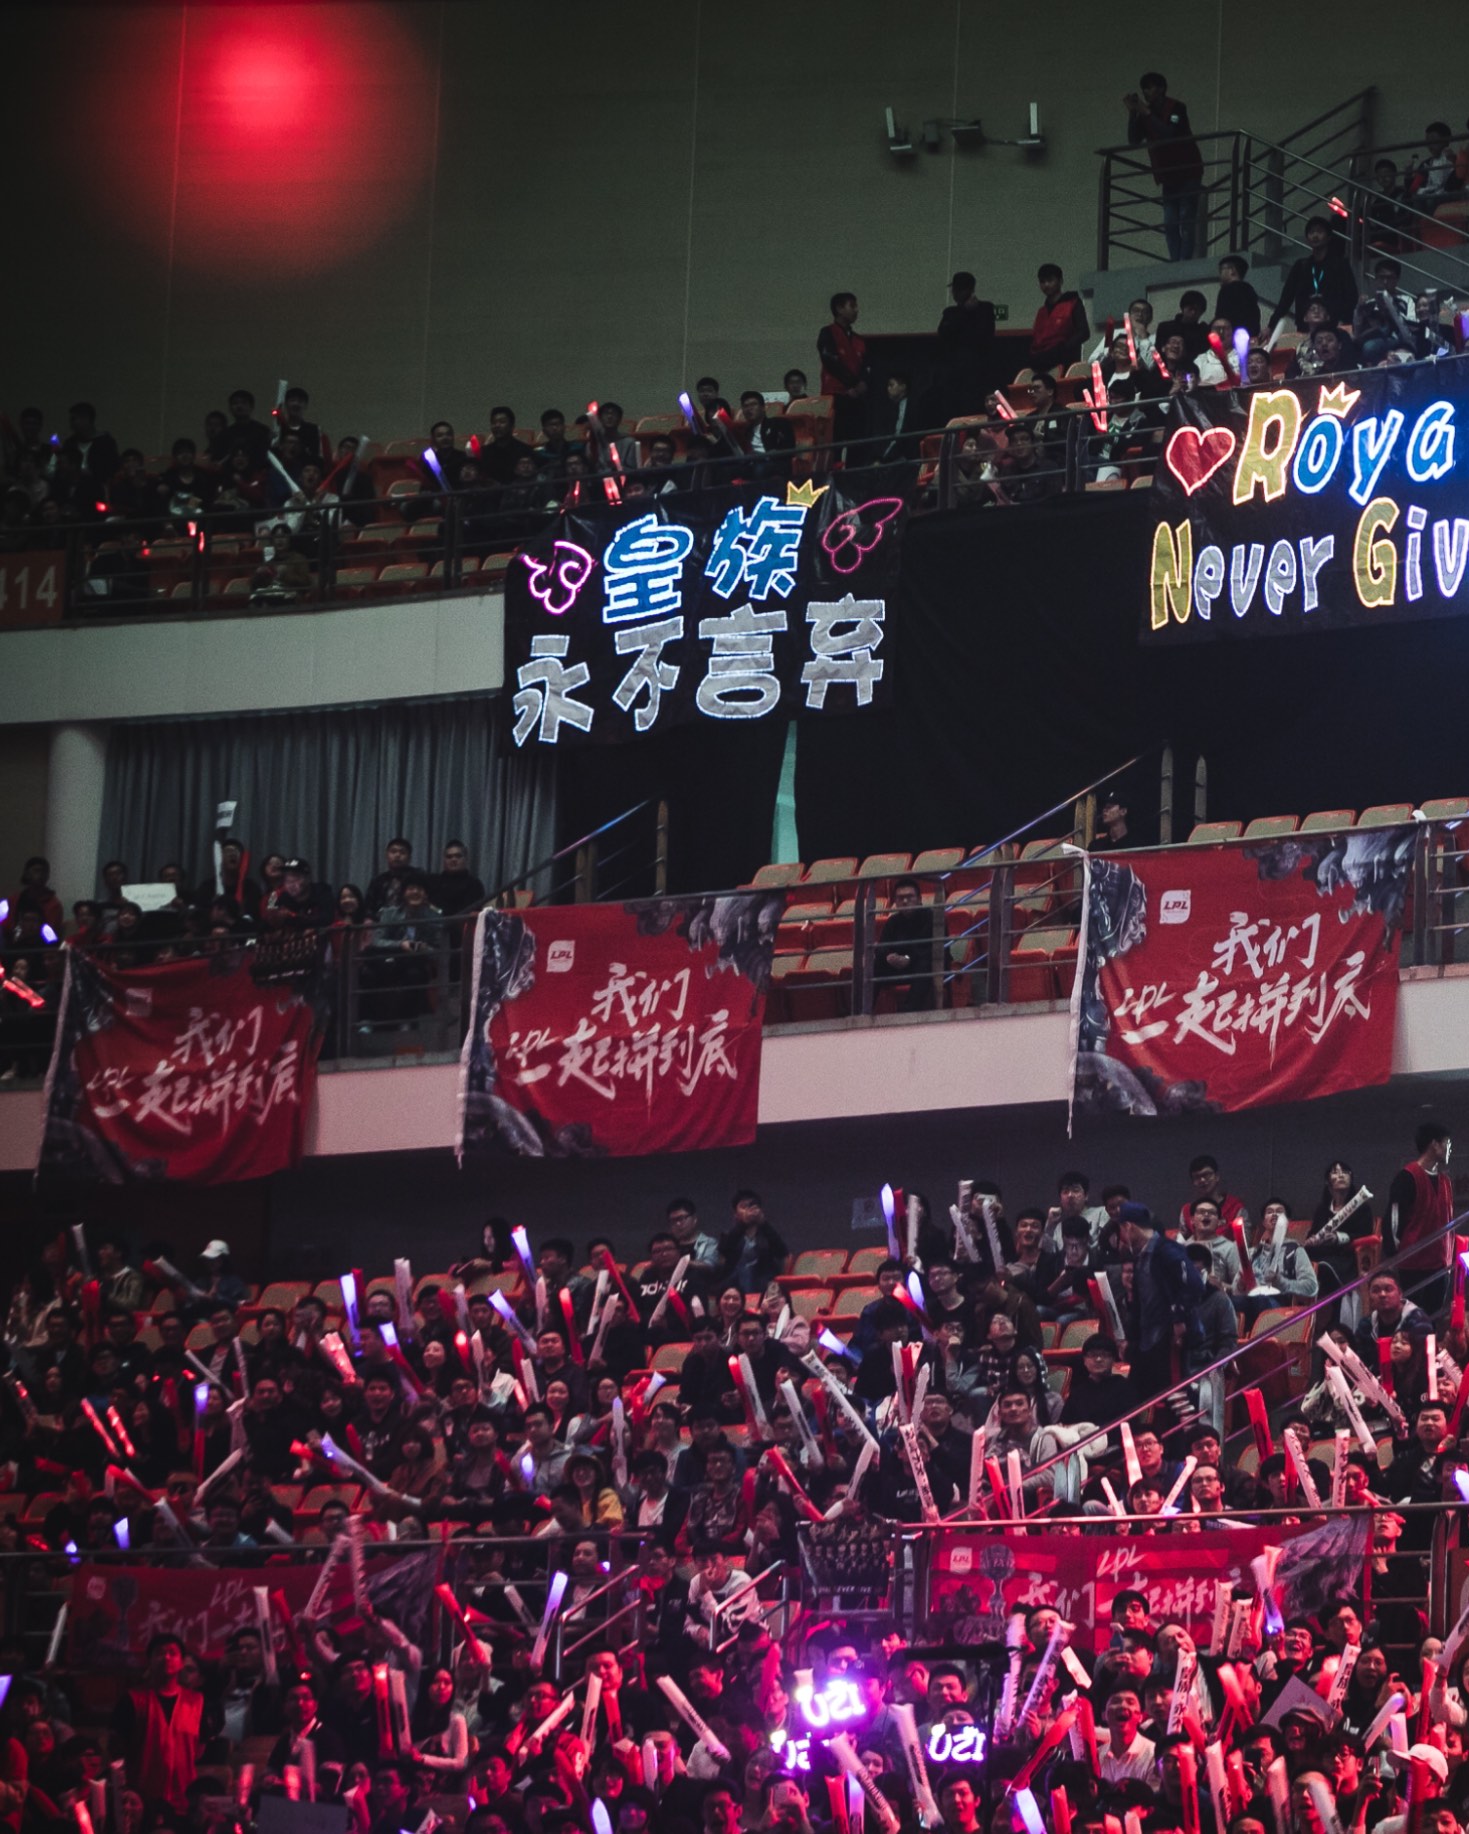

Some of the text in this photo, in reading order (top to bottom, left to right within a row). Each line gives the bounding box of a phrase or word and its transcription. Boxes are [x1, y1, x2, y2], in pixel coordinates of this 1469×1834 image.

[603, 496, 807, 623] 皇族
[1149, 518, 1335, 630] Never
[512, 592, 886, 746] 永不言弃
[1163, 900, 1189, 911] LPL
[551, 950, 573, 960] LPL
[1211, 911, 1321, 978] 我们
[591, 962, 691, 1027] 我们
[171, 1006, 263, 1066] 我们
[1096, 1545, 1146, 1583] LPL
